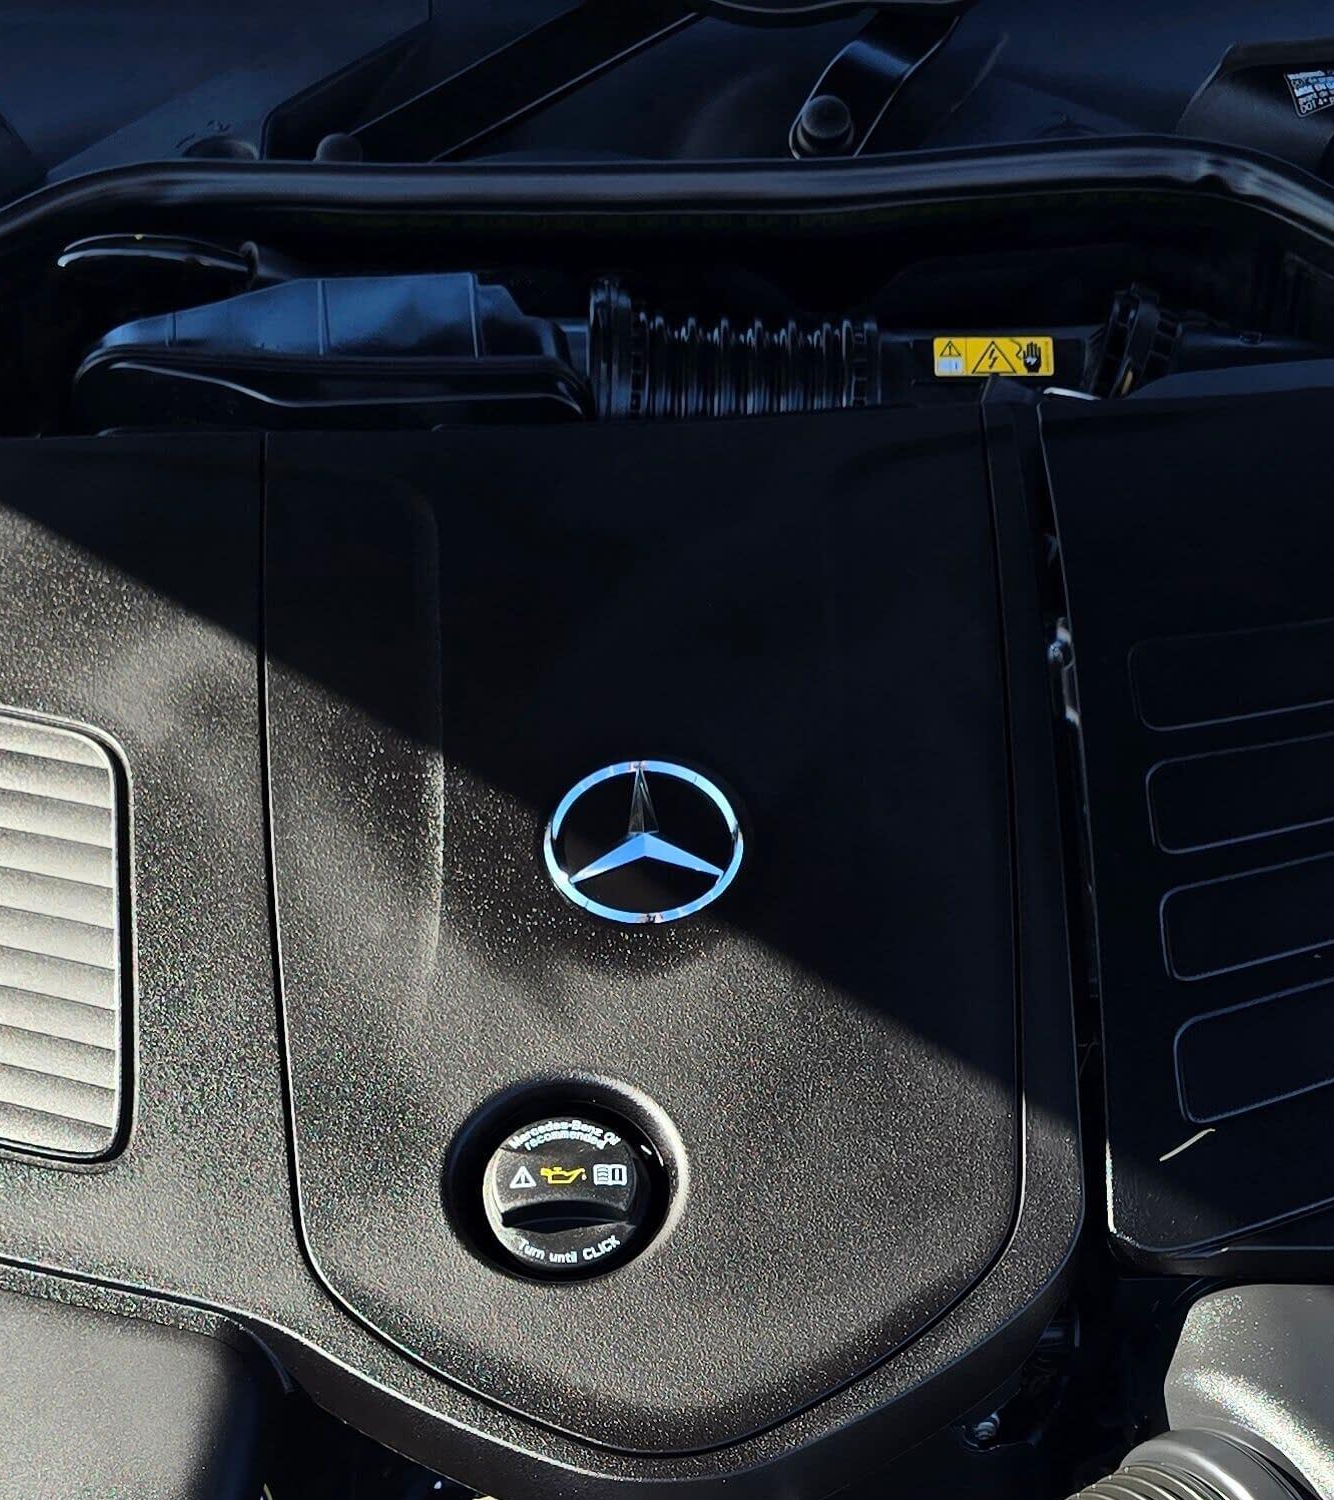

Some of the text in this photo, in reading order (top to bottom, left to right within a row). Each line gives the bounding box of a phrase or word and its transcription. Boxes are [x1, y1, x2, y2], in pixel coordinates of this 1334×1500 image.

[508, 1120, 603, 1149] Mercedes-Benz
[524, 1130, 608, 1151] recommended
[518, 1235, 621, 1263] Turn until CLICK
